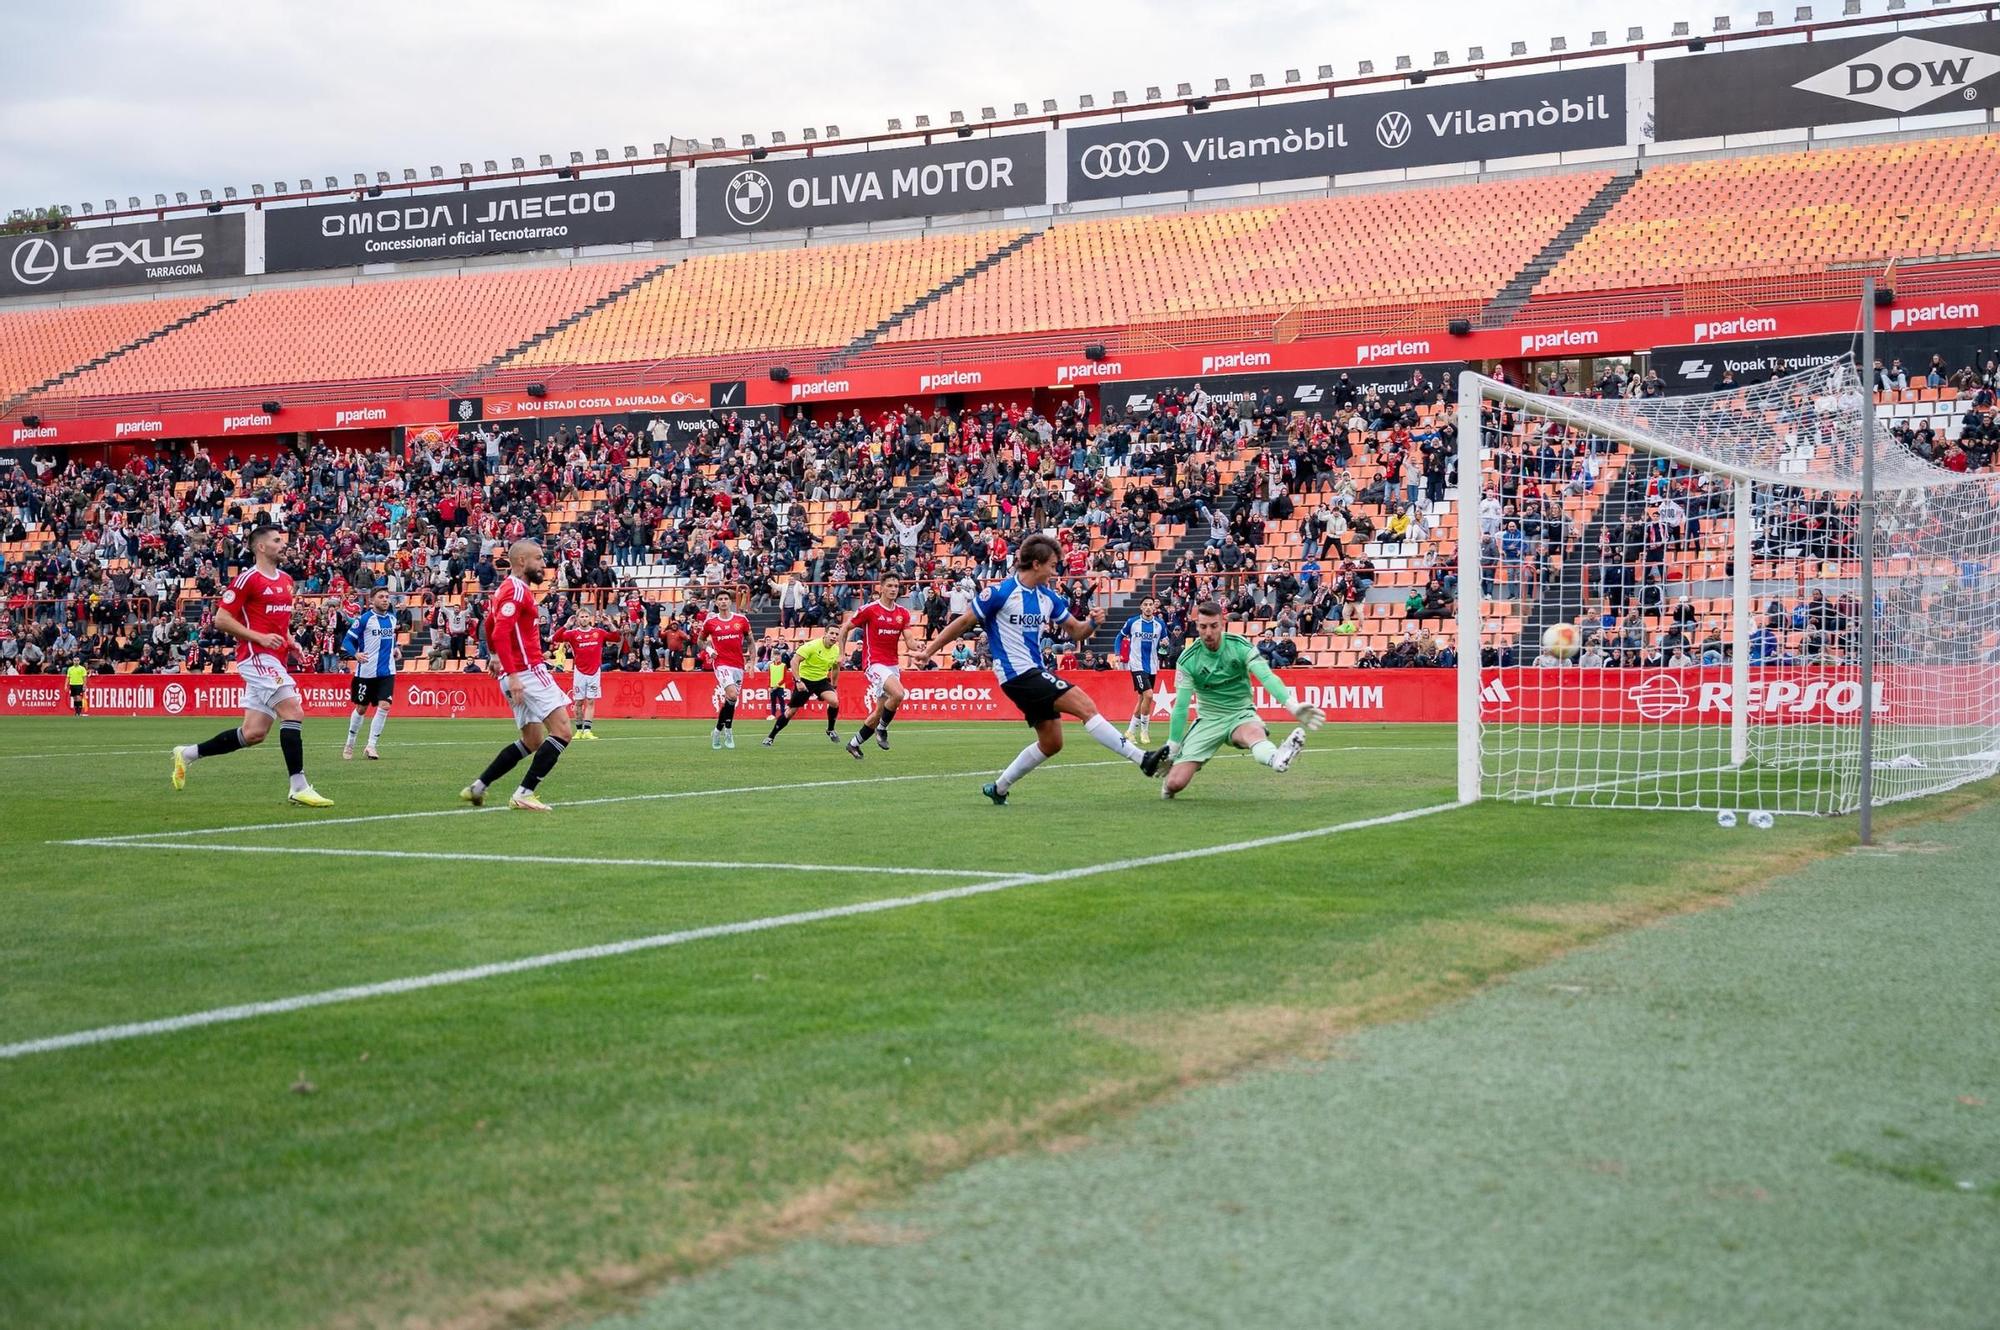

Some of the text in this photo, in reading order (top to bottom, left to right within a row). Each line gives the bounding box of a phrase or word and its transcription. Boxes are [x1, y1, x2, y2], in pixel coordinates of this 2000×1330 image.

[1846, 56, 1974, 96] DOW
[1426, 94, 1610, 137] Vilamòbil
[1182, 123, 1349, 163] Vilamòbil
[787, 157, 1014, 209] OLIVA MOTOR
[321, 190, 616, 237] OMODA JAECOO
[364, 224, 568, 252] Concessionari oficial Tecnotarraco
[63, 233, 205, 271] LEXUS
[145, 263, 203, 278] TARRAGONA
[1906, 303, 1979, 327] parlem
[1709, 317, 1777, 339] parlem
[1370, 340, 1430, 361] parlem
[1535, 329, 1598, 352] parlem
[1068, 361, 1121, 381] parlem
[1214, 351, 1271, 372] parlem
[1723, 356, 1766, 373] Vopak
[802, 380, 849, 397] parlem
[931, 371, 982, 389] parlem
[517, 394, 667, 411] NOU ESTADI COSTA DAURADA
[232, 413, 271, 430] parlem
[345, 407, 386, 424] parlem
[677, 419, 706, 432] Vopak
[20, 427, 57, 442] parlem
[124, 419, 163, 435] parlem
[17, 689, 61, 701] VERSUS
[303, 688, 352, 701] VERSUS
[1305, 685, 1384, 709] DAMM
